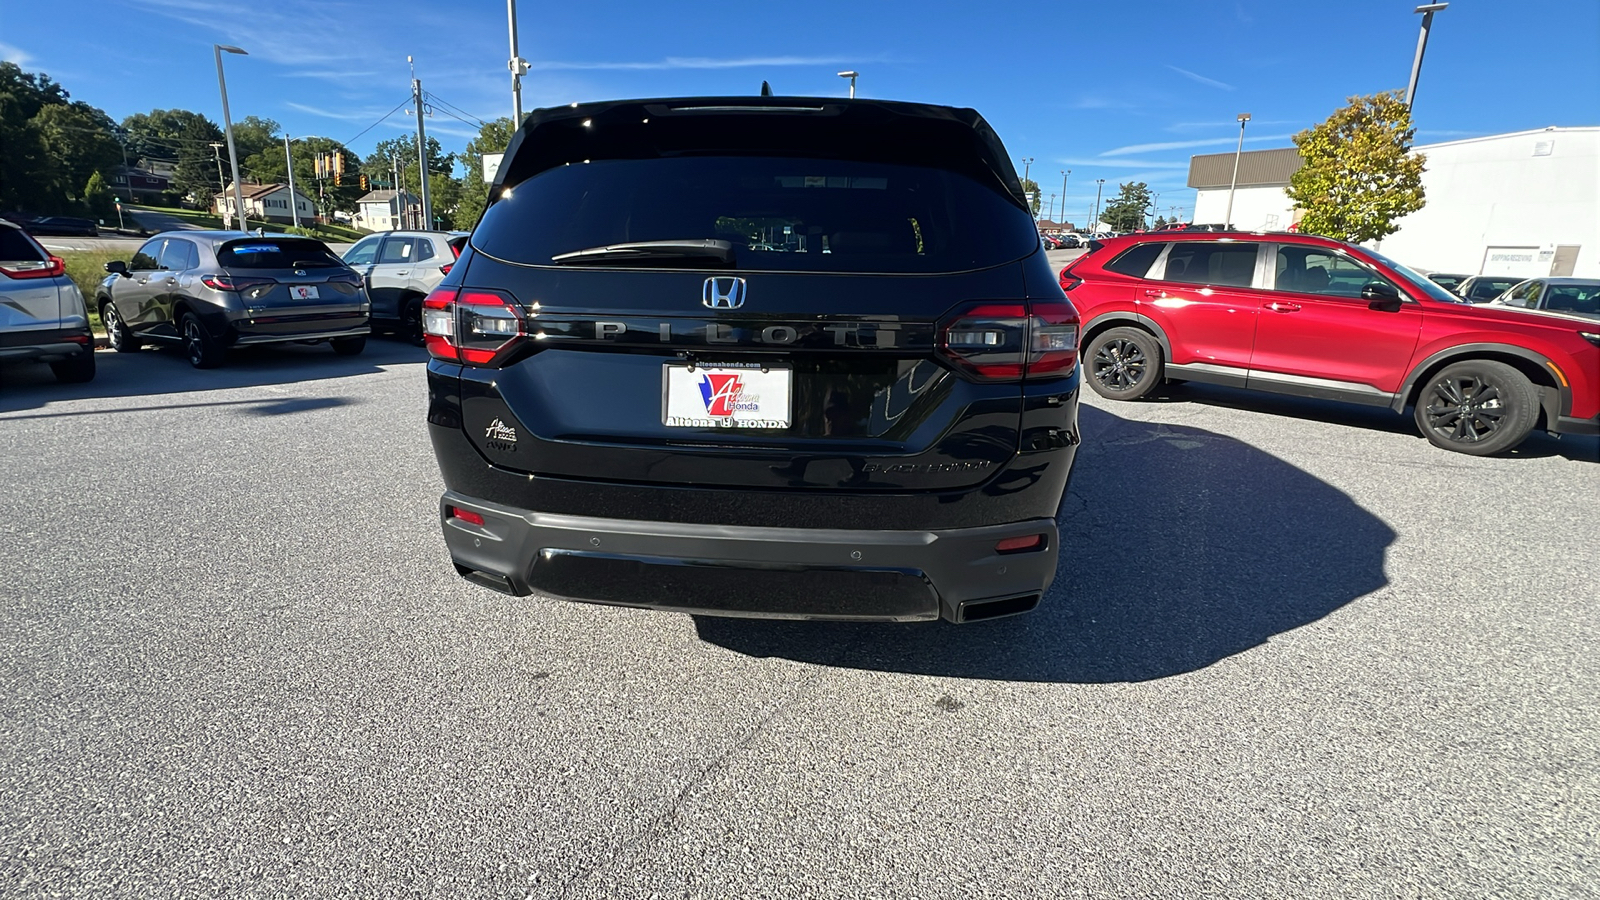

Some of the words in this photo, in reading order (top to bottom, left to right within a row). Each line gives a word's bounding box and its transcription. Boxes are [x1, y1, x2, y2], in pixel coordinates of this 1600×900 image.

[595, 321, 859, 345] PILOT
[728, 402, 759, 411] Honda
[666, 417, 716, 427] Altoona
[737, 419, 788, 429] HONDA
